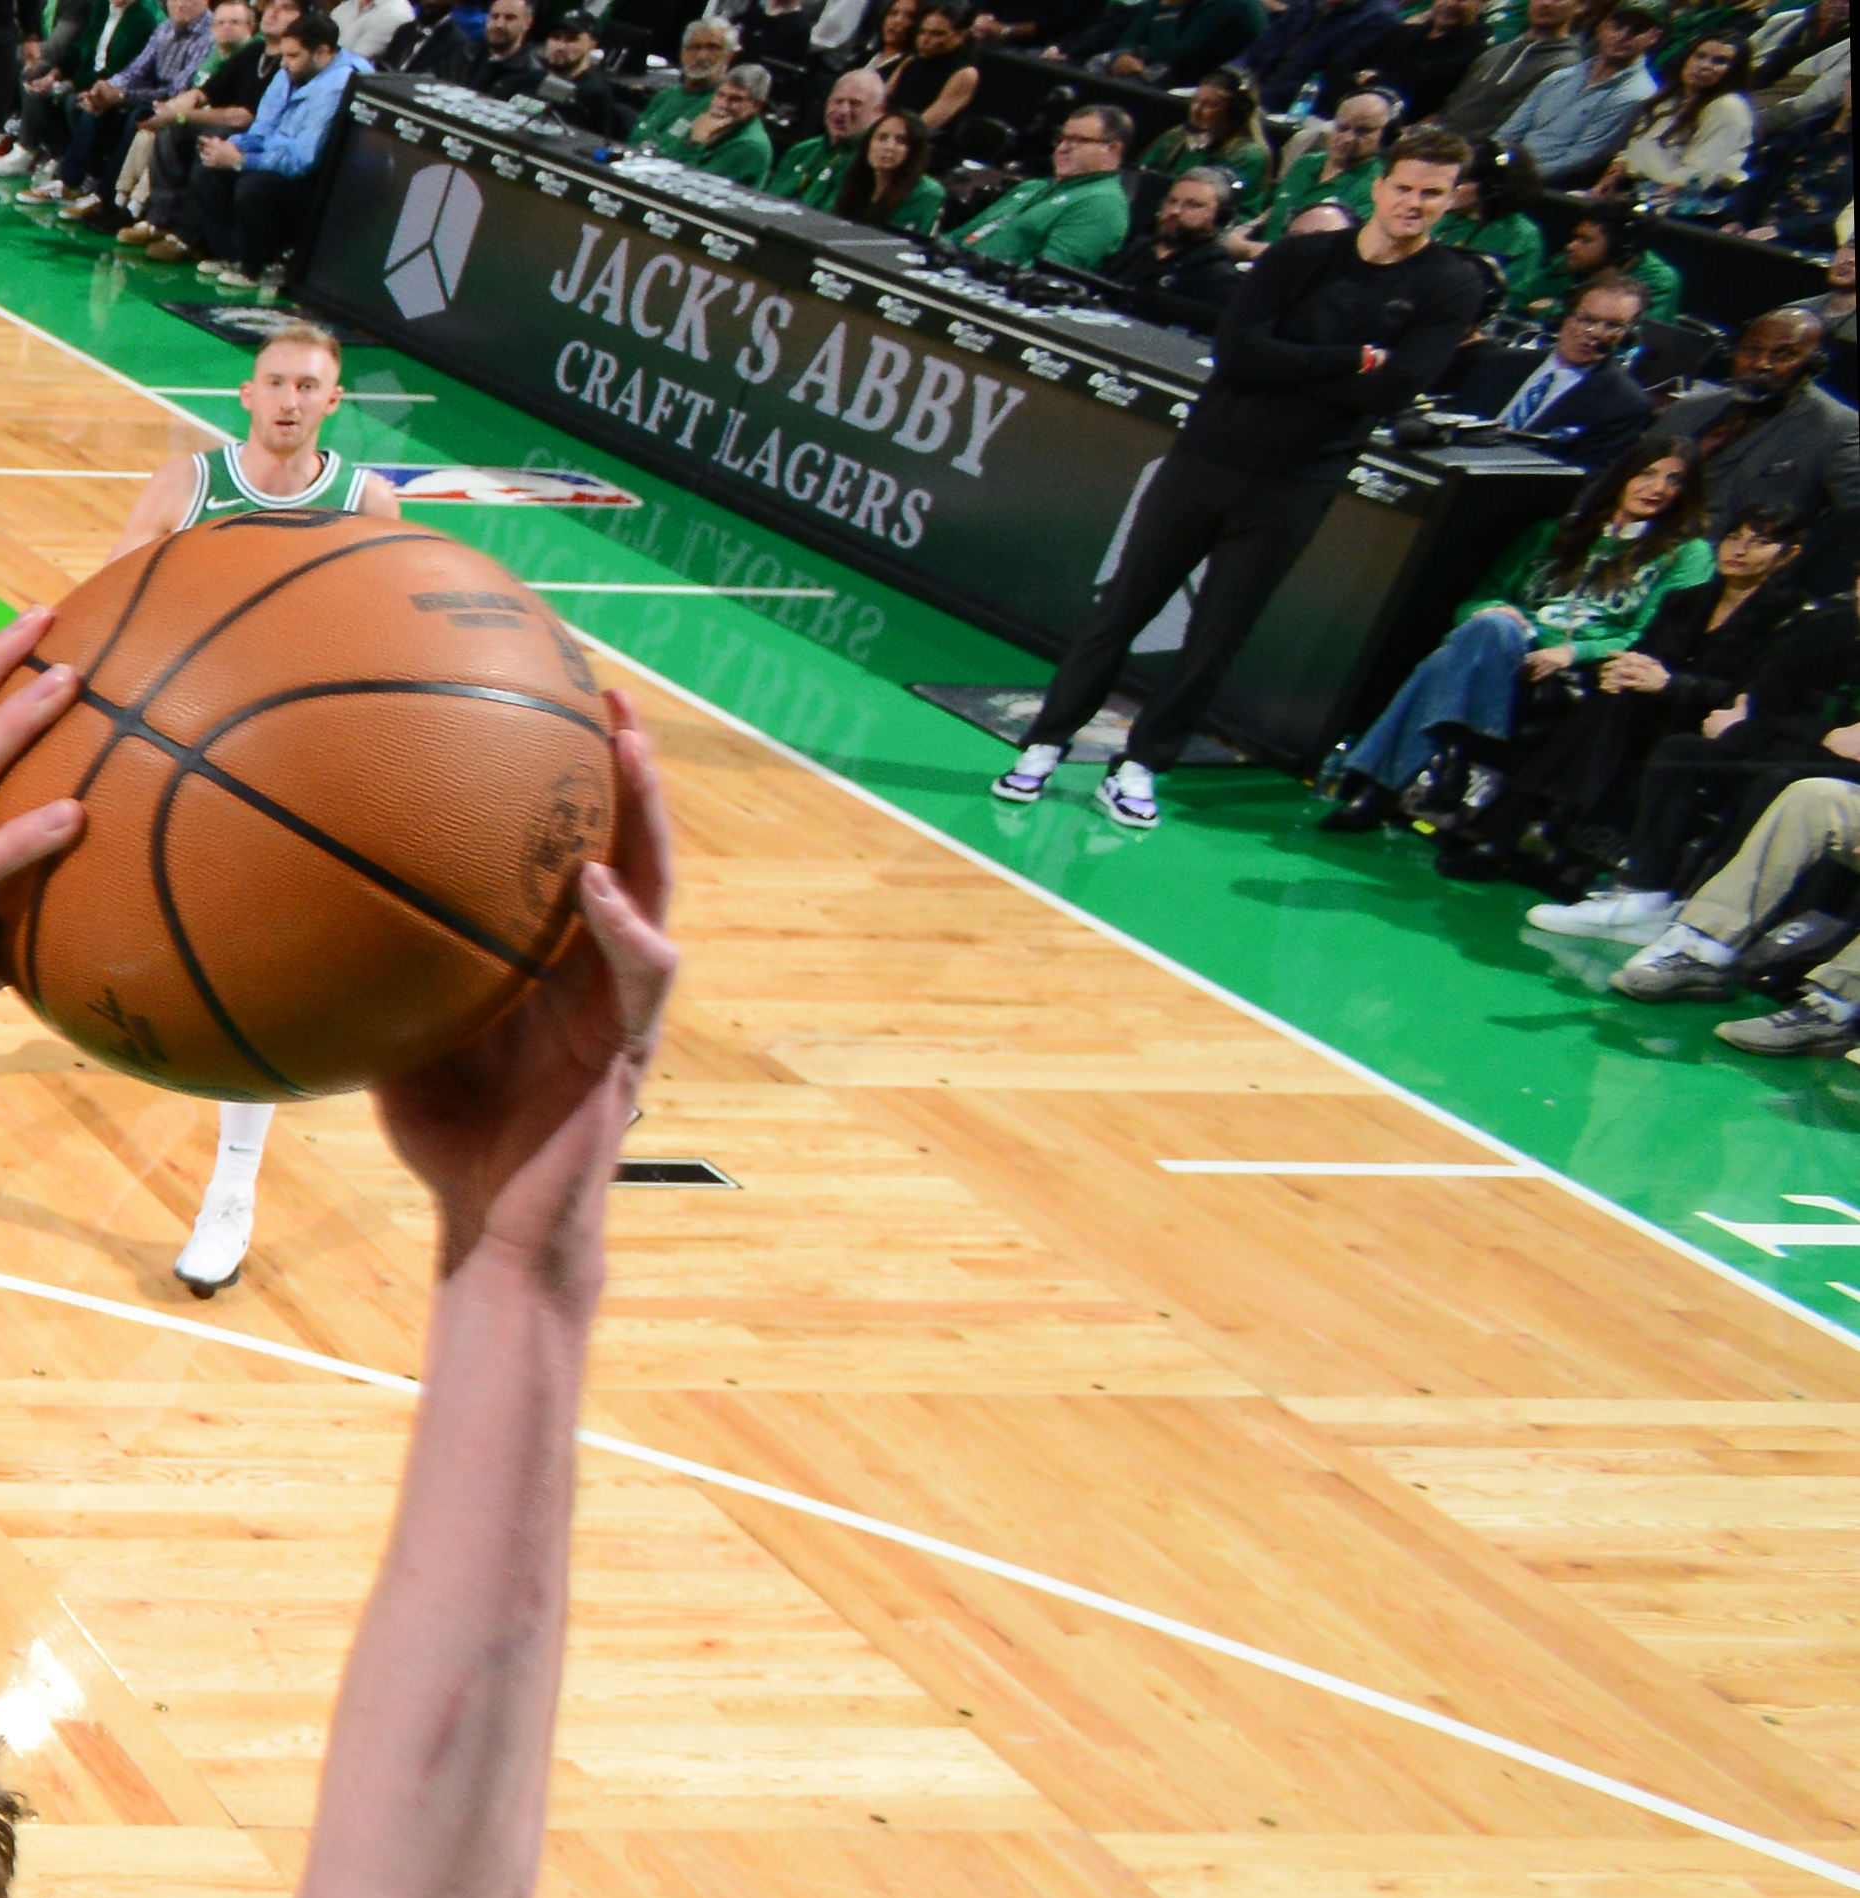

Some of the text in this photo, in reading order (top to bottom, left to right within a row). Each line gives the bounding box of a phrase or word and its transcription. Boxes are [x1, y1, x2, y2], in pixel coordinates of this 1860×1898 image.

[547, 221, 1026, 480] JACK'S ABBY
[554, 338, 714, 463] CRAFT
[713, 404, 934, 551] LAGERS
